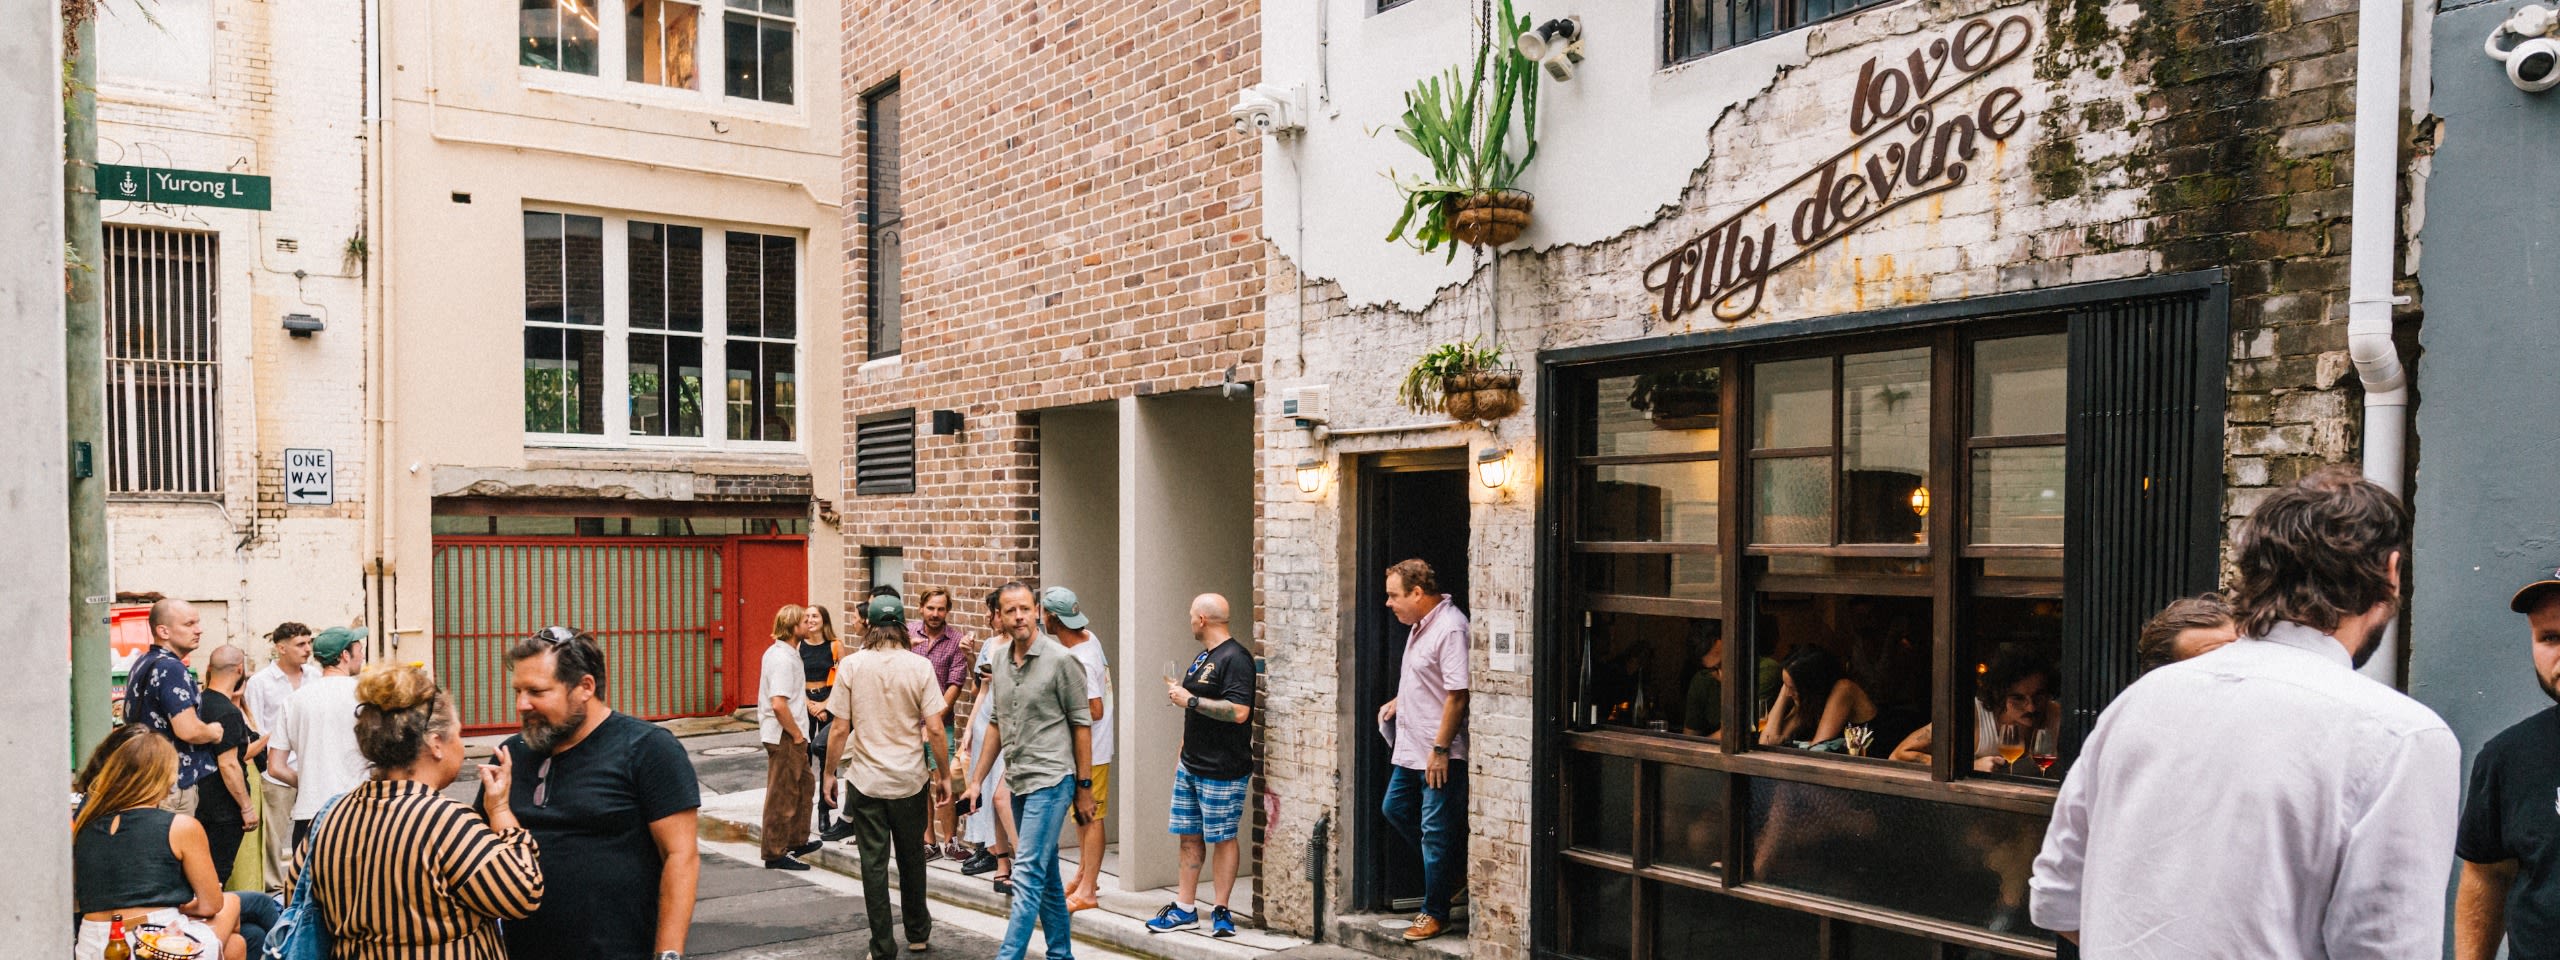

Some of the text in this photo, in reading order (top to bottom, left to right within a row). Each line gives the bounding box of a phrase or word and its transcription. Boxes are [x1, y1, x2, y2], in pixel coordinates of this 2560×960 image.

[1850, 15, 2032, 135] love
[156, 173, 244, 199] Yurong L
[1643, 86, 2026, 322] tilly devine
[293, 454, 326, 467] ONE
[291, 471, 327, 484] WAY
